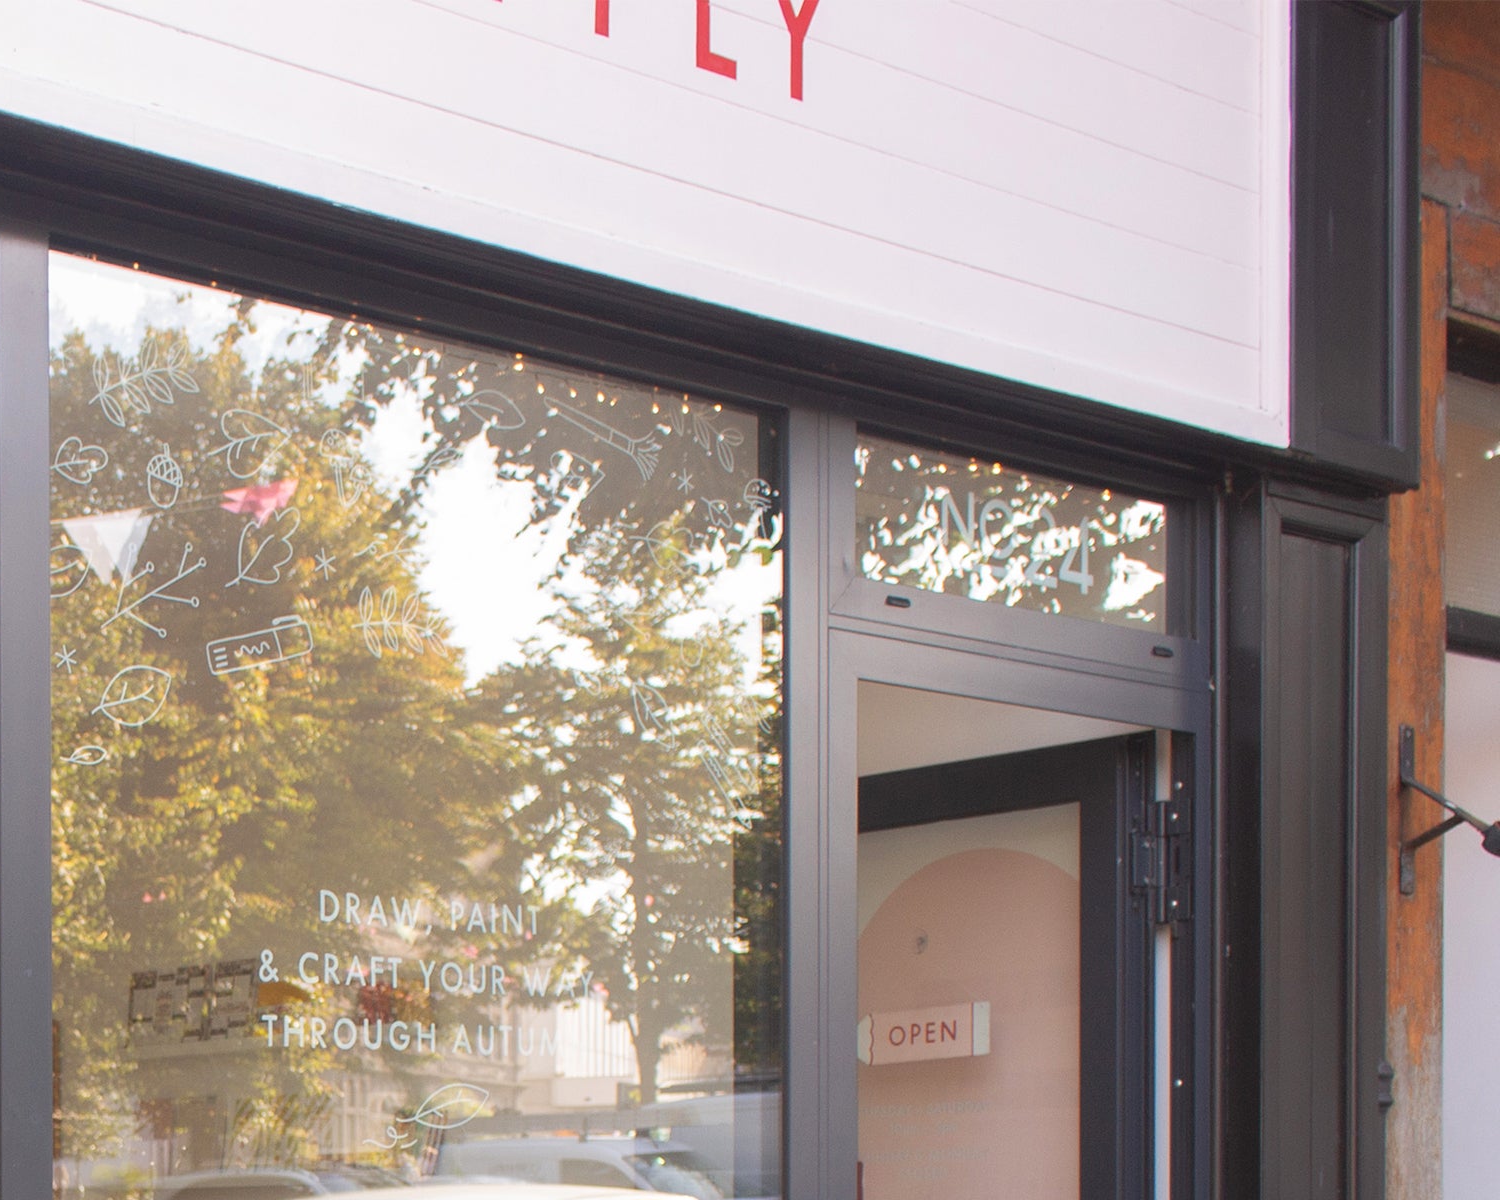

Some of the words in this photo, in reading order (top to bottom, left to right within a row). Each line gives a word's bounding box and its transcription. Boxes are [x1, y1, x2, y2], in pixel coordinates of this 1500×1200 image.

[319, 889, 433, 935] DRAW,
[450, 900, 540, 935] PAINT
[258, 949, 279, 983] &
[298, 952, 403, 989] CRAFT
[419, 960, 506, 995] YOUR
[523, 966, 595, 998] WAY
[261, 1013, 437, 1053] THROUGH
[452, 1023, 564, 1057] AUTUM
[888, 1019, 957, 1047] OPEN
